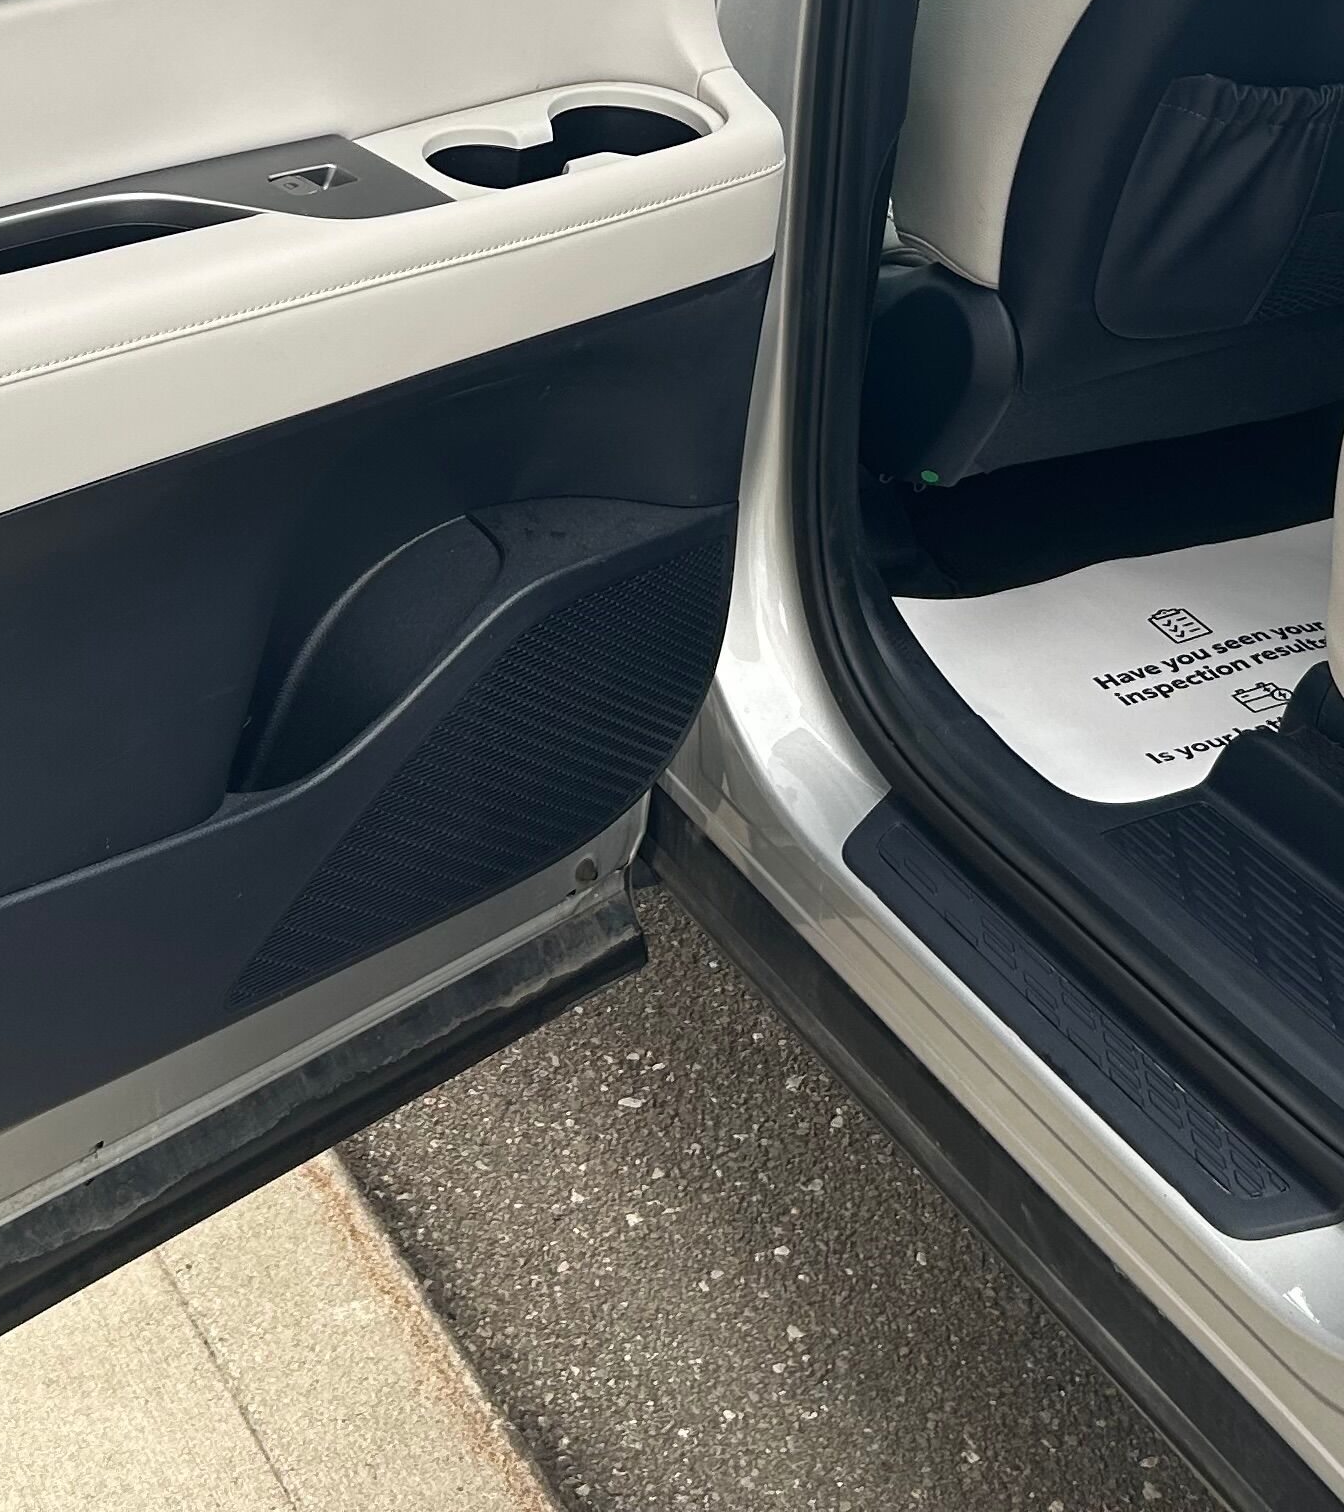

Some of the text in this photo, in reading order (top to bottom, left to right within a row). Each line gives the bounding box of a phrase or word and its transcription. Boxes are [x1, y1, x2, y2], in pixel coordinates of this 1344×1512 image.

[1092, 620, 1326, 690] Have you seen your
[1113, 635, 1327, 707] inspection results
[1145, 732, 1233, 765] Is your
